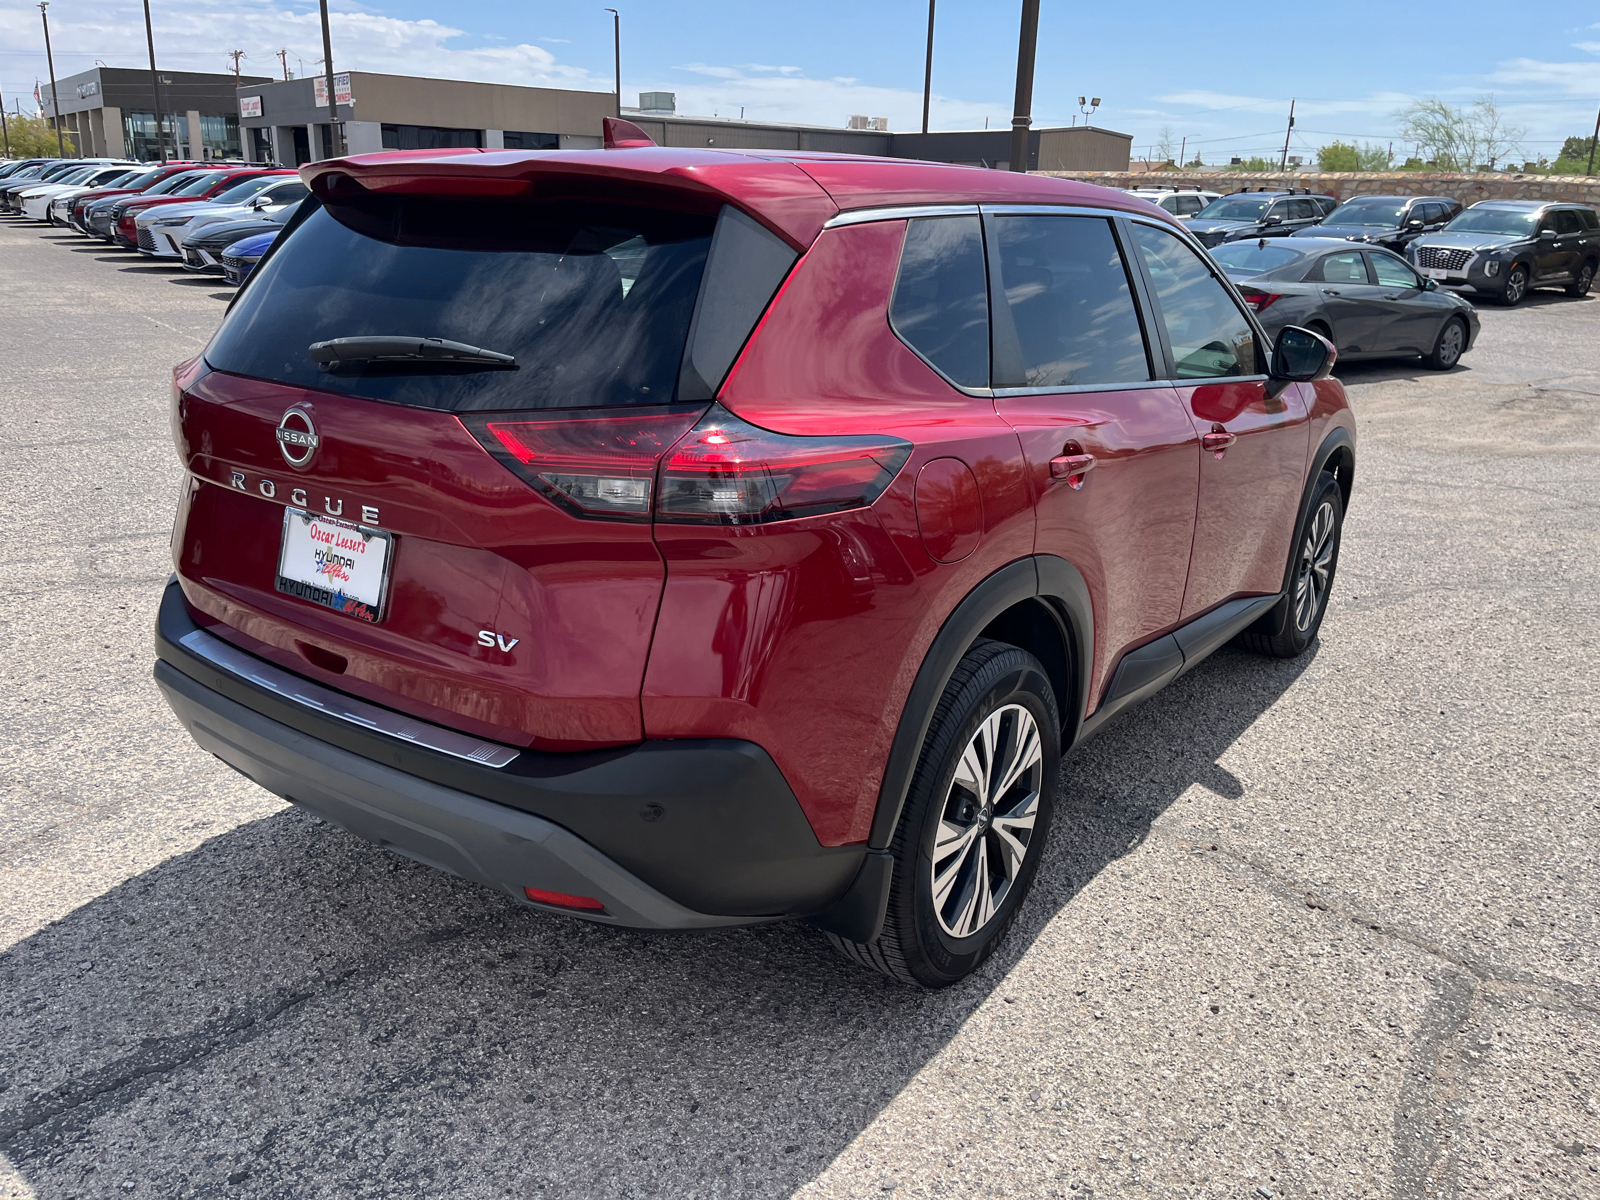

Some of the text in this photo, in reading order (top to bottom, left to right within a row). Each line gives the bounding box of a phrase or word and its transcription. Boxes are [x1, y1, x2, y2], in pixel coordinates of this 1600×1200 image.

[276, 428, 318, 446] NISSAN
[231, 471, 380, 525] ROGUE
[310, 523, 366, 554] Oscar Leeser's
[314, 548, 355, 570] HYUNDAI
[279, 577, 333, 606] HYUNDAI
[477, 630, 519, 653] SV
